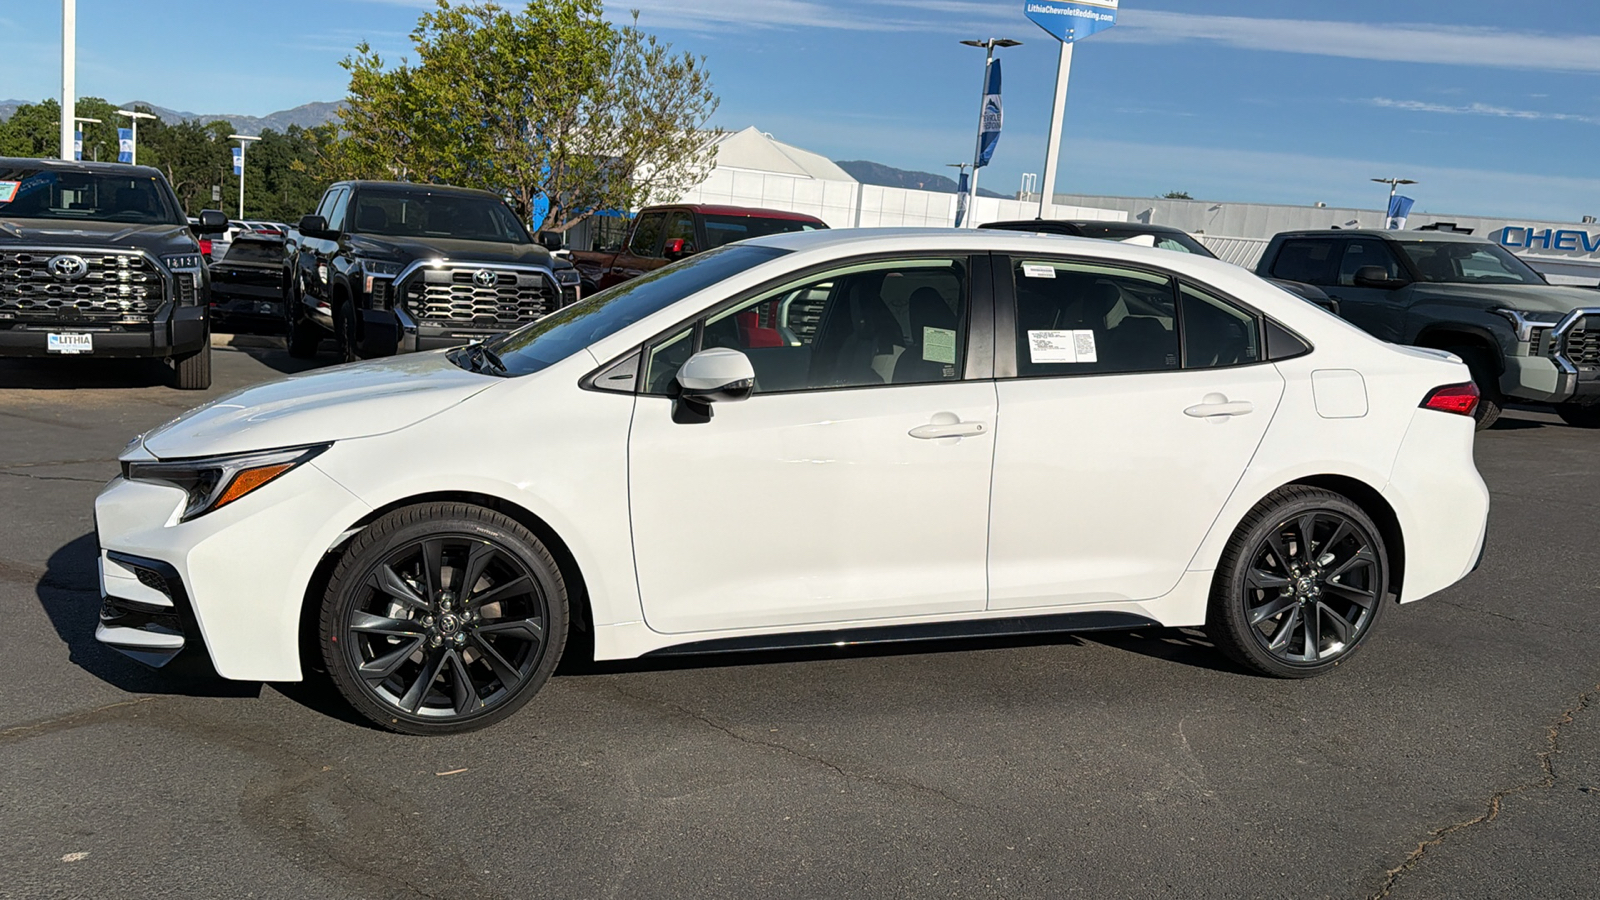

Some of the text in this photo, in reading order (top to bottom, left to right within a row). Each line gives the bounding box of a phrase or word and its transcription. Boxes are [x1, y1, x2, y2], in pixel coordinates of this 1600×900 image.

[1027, 4, 1114, 22] LithiaChevroletRedding.com
[1501, 226, 1600, 252] CHEV
[59, 336, 91, 345] LITHIA
